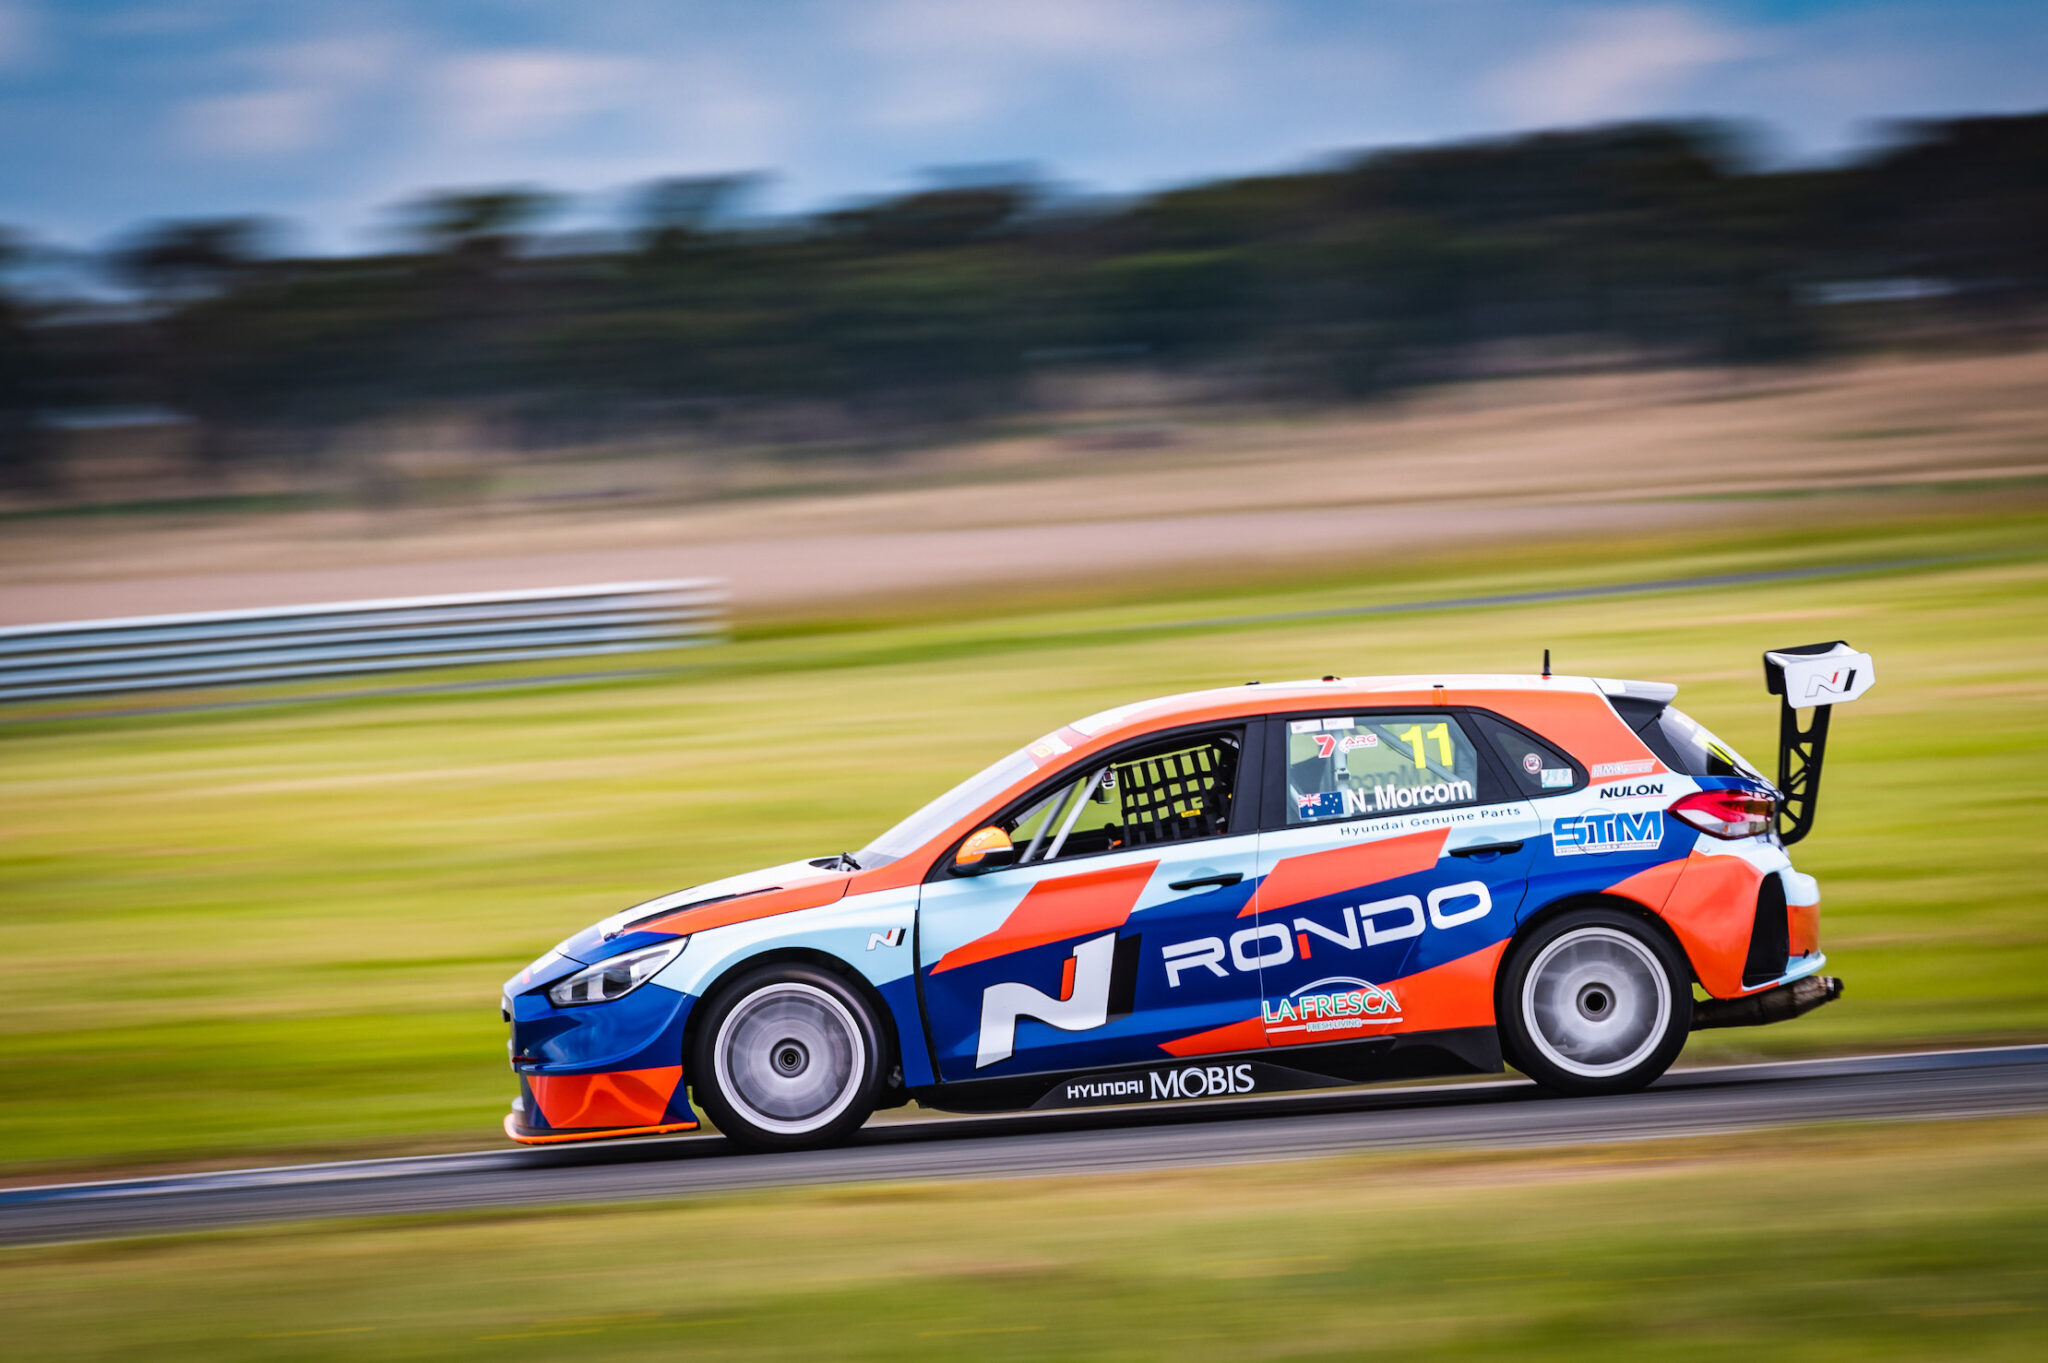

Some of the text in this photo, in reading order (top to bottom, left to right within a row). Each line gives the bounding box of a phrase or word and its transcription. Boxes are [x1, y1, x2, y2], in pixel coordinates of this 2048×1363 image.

[1400, 723, 1453, 769] 11
[1347, 780, 1473, 814] N. Morcom
[1600, 784, 1664, 799] NULON
[1340, 808, 1521, 836] Hyundai Genuine Parts
[1552, 810, 1663, 847] STM
[1162, 879, 1493, 988] RONDO
[1263, 991, 1400, 1023] LA FRESCA
[1067, 1064, 1255, 1100] HYUNDAI MOBIS
